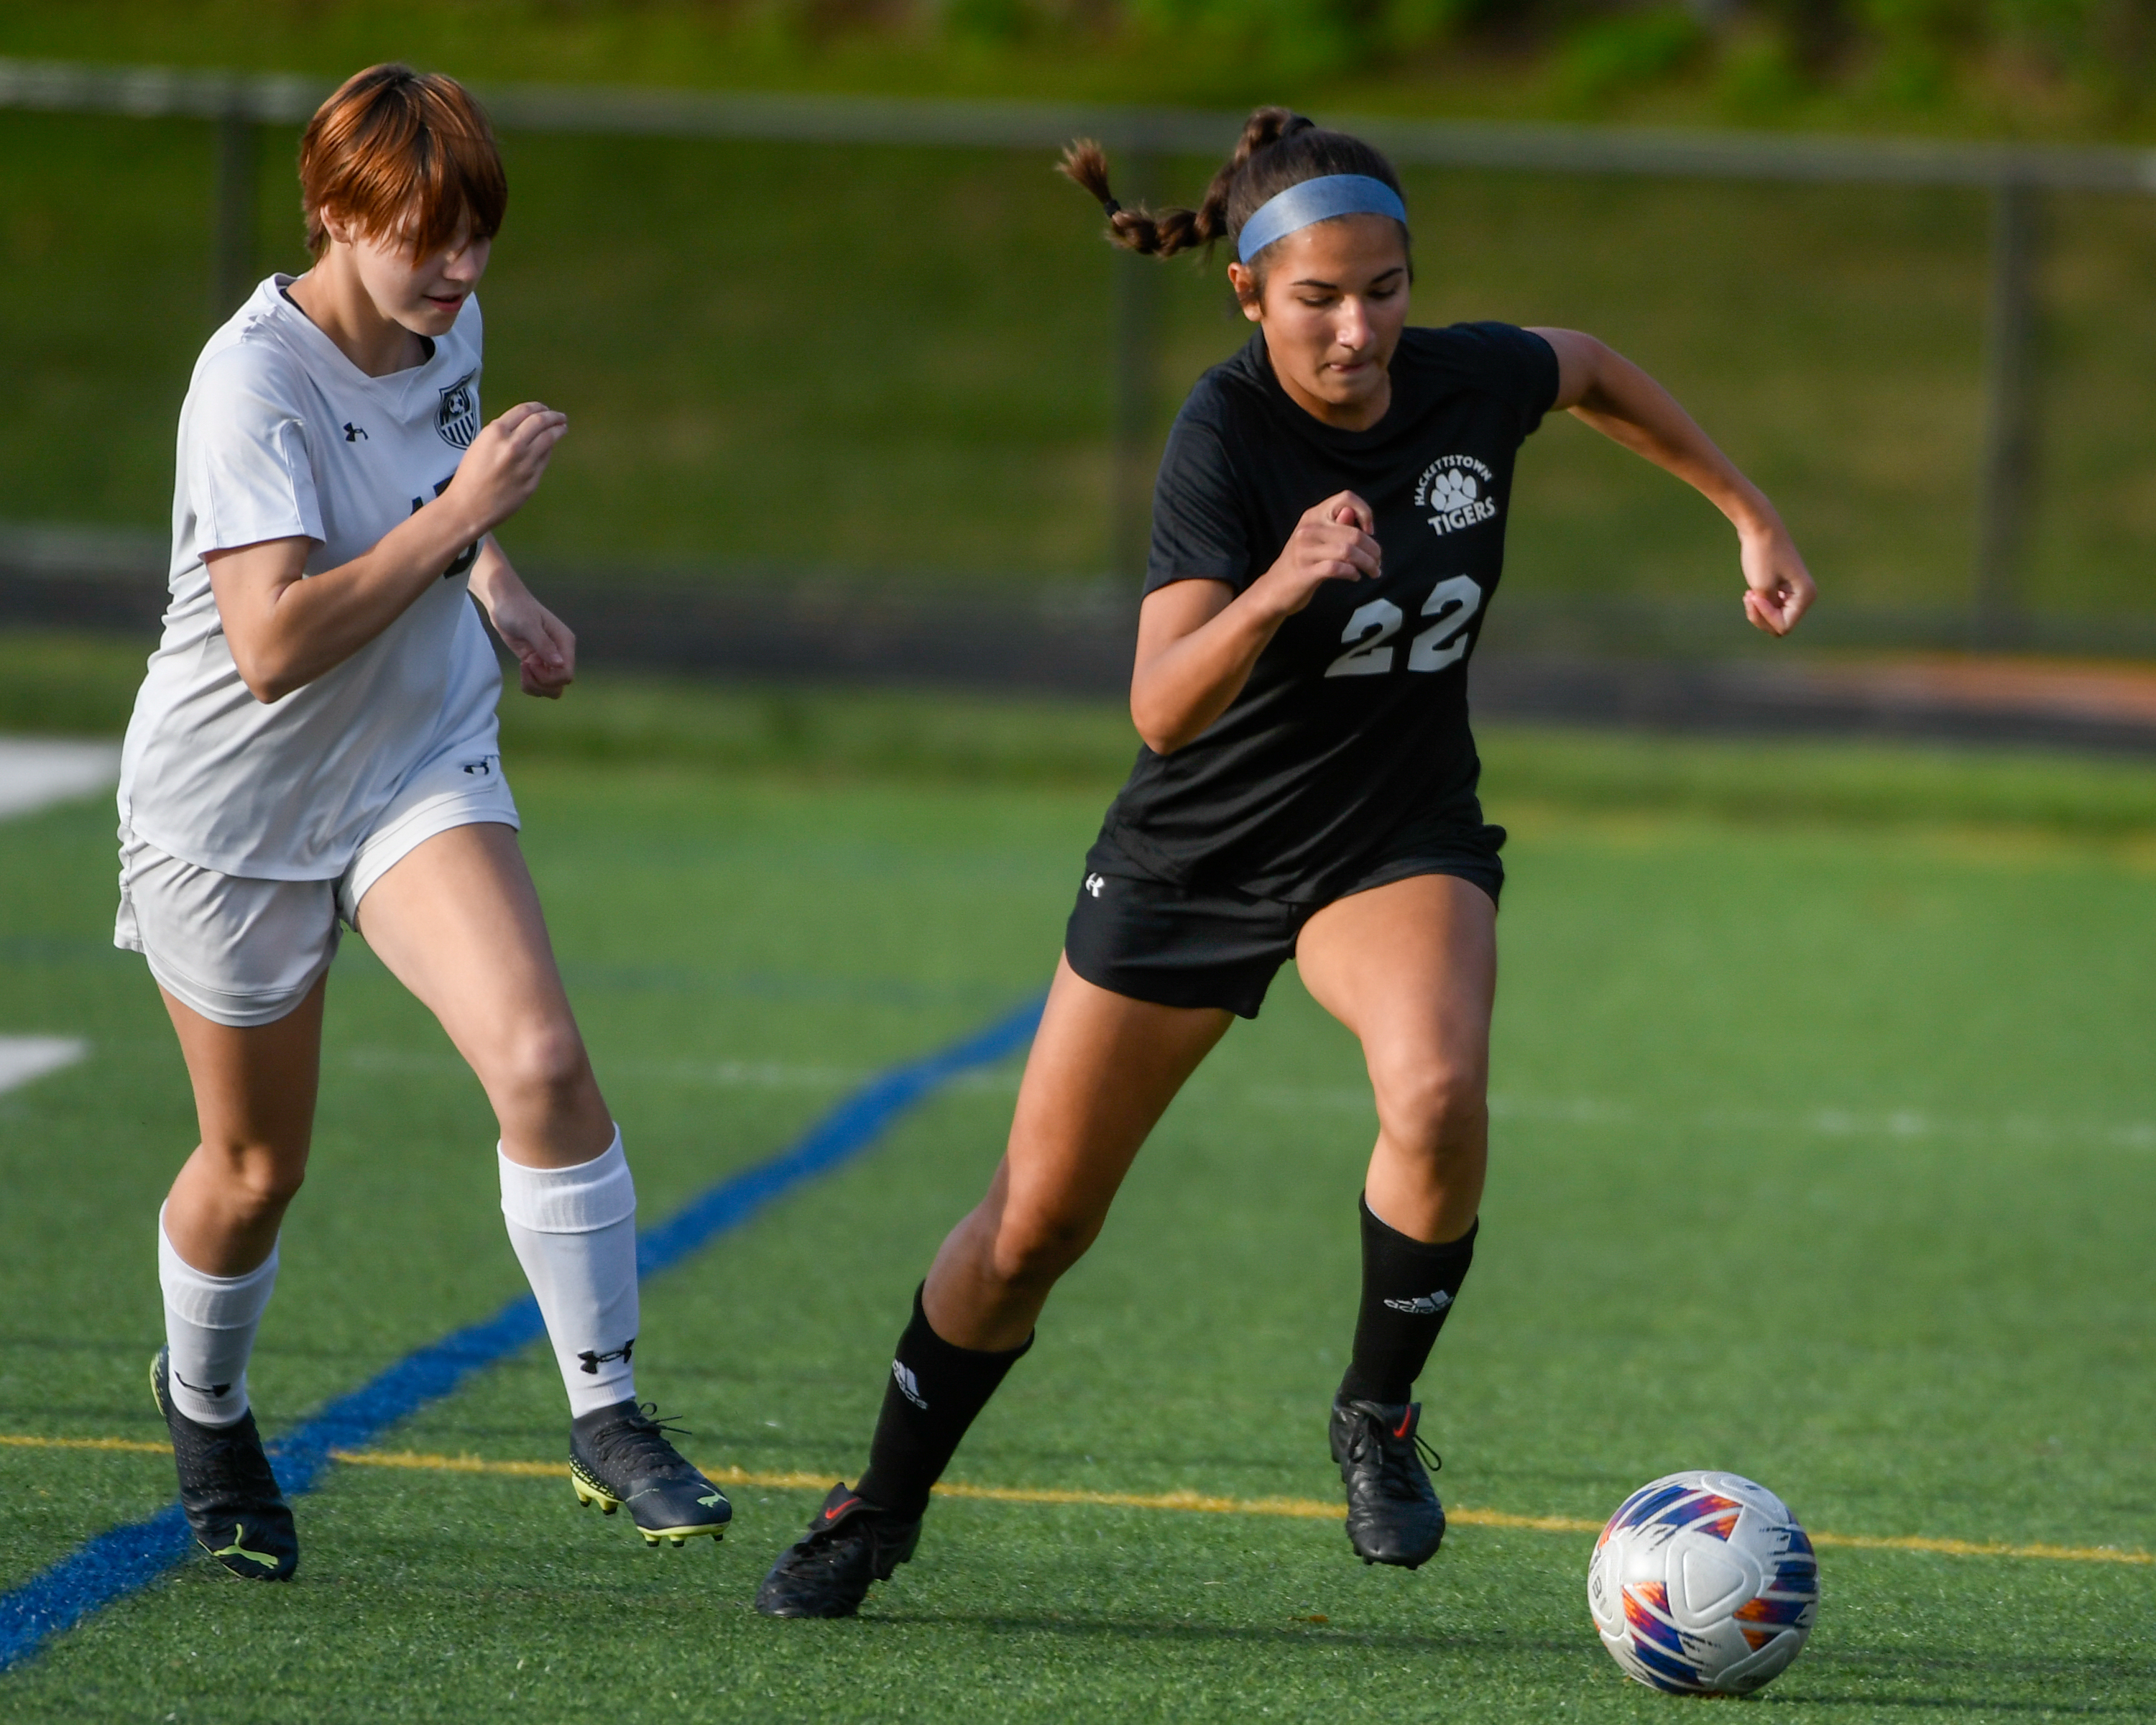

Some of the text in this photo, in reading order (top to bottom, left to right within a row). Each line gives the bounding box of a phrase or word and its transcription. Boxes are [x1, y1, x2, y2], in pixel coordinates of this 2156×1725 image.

[1414, 454, 1493, 506] HACKETTSTOWN
[1427, 496, 1496, 535] TIGERS
[1325, 574, 1481, 677] 22
